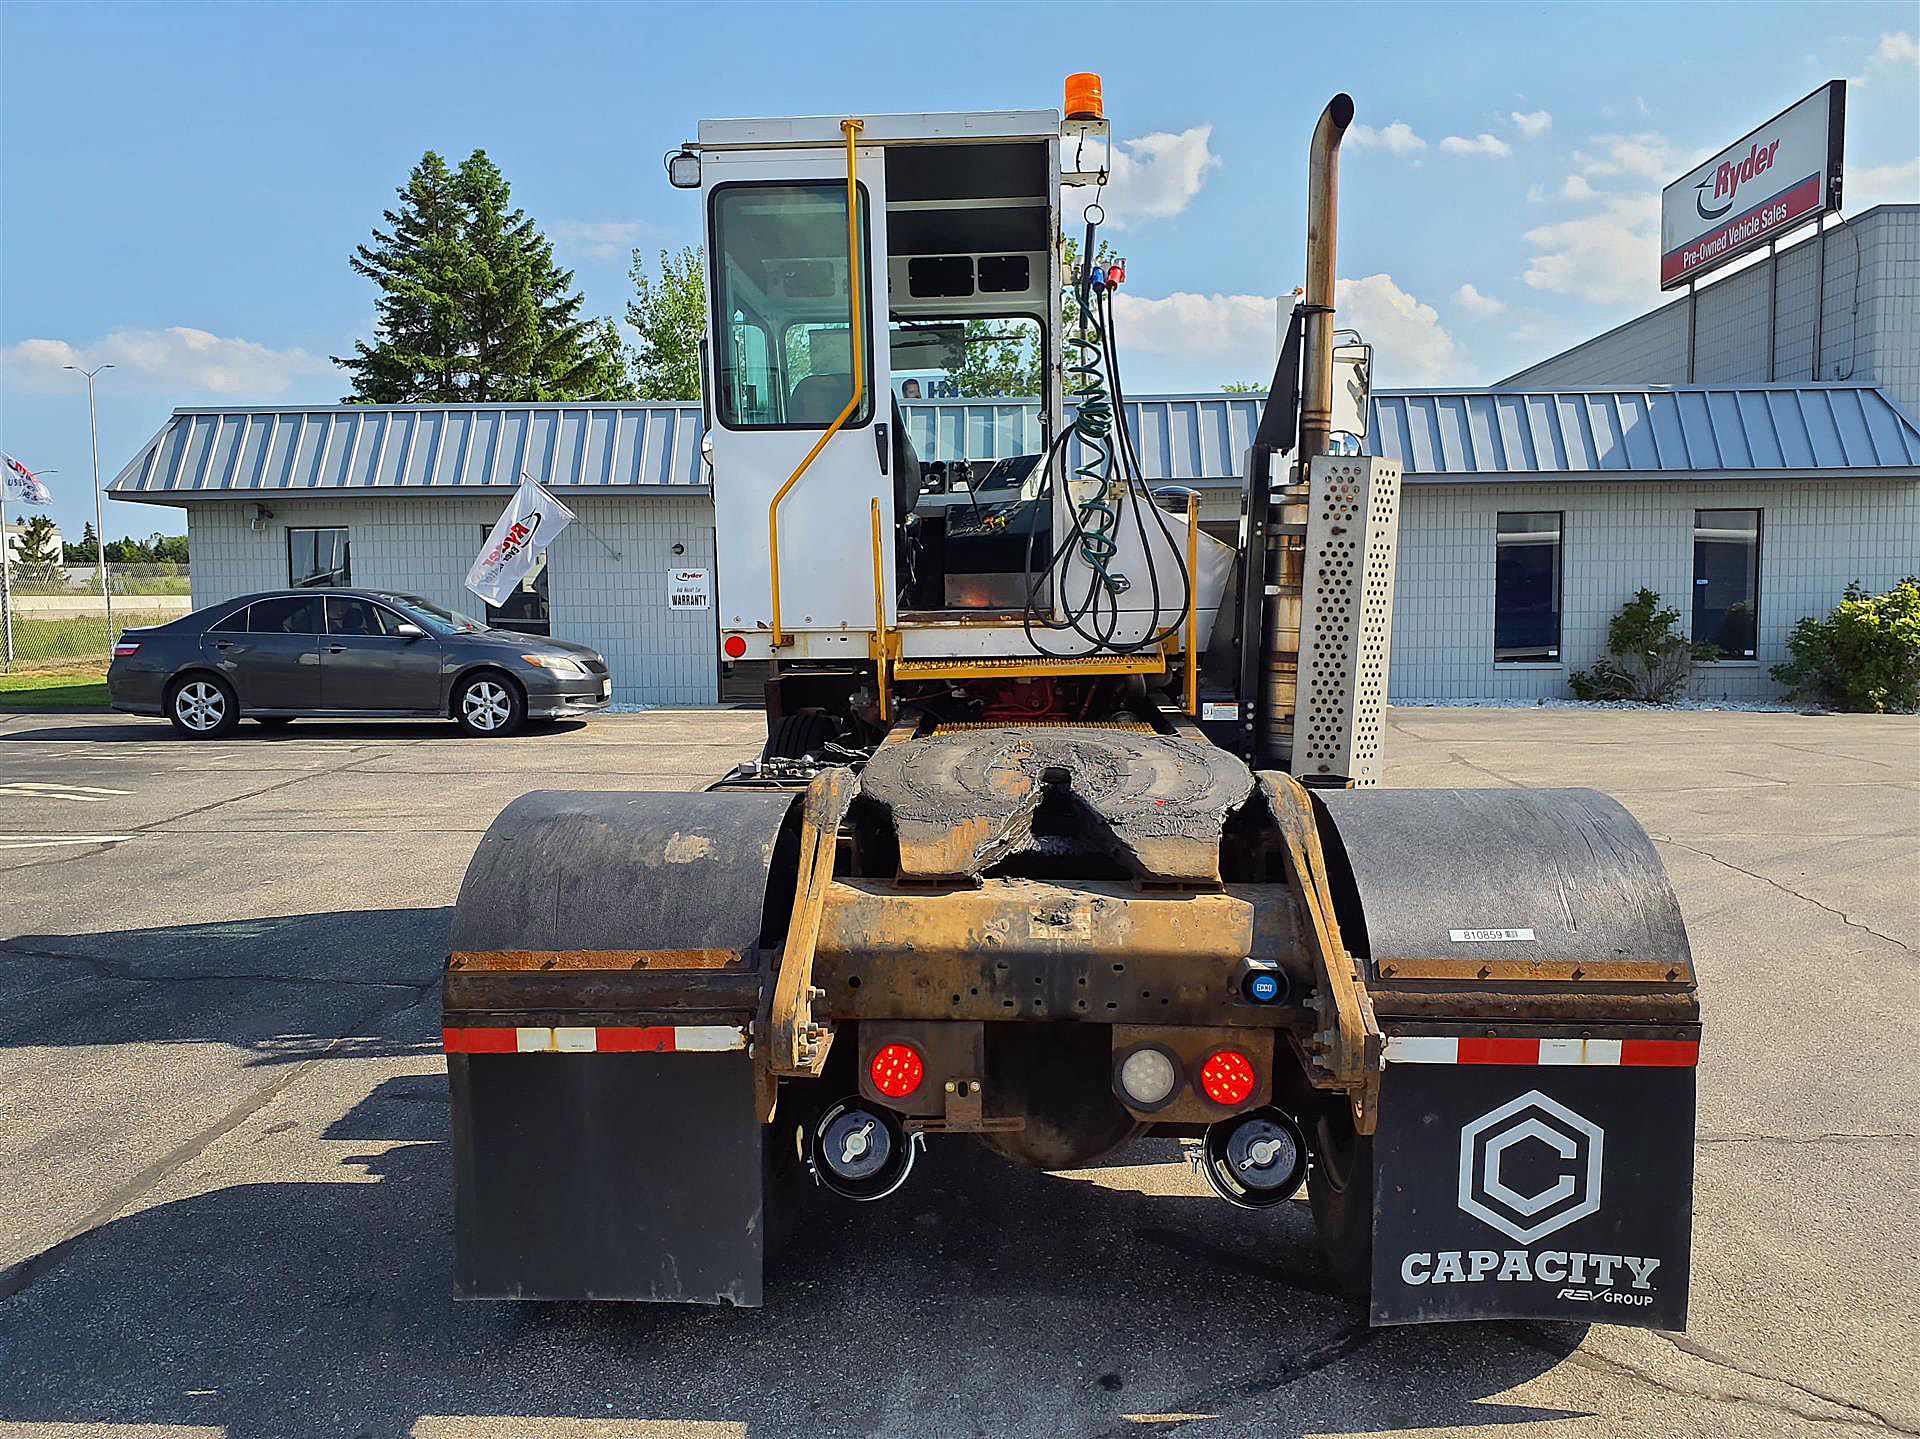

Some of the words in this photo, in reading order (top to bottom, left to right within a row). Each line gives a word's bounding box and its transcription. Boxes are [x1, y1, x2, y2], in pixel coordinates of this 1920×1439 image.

[1714, 138, 1780, 199] Ryder
[1683, 232, 1727, 269] Pre-Owned
[1728, 216, 1760, 245] Vehicle
[1761, 203, 1787, 229] Sales
[682, 572, 703, 580] Ryder
[672, 594, 707, 606] WARRANTY
[1463, 930, 1503, 940] 810859
[1400, 1250, 1661, 1290] CAPACITY
